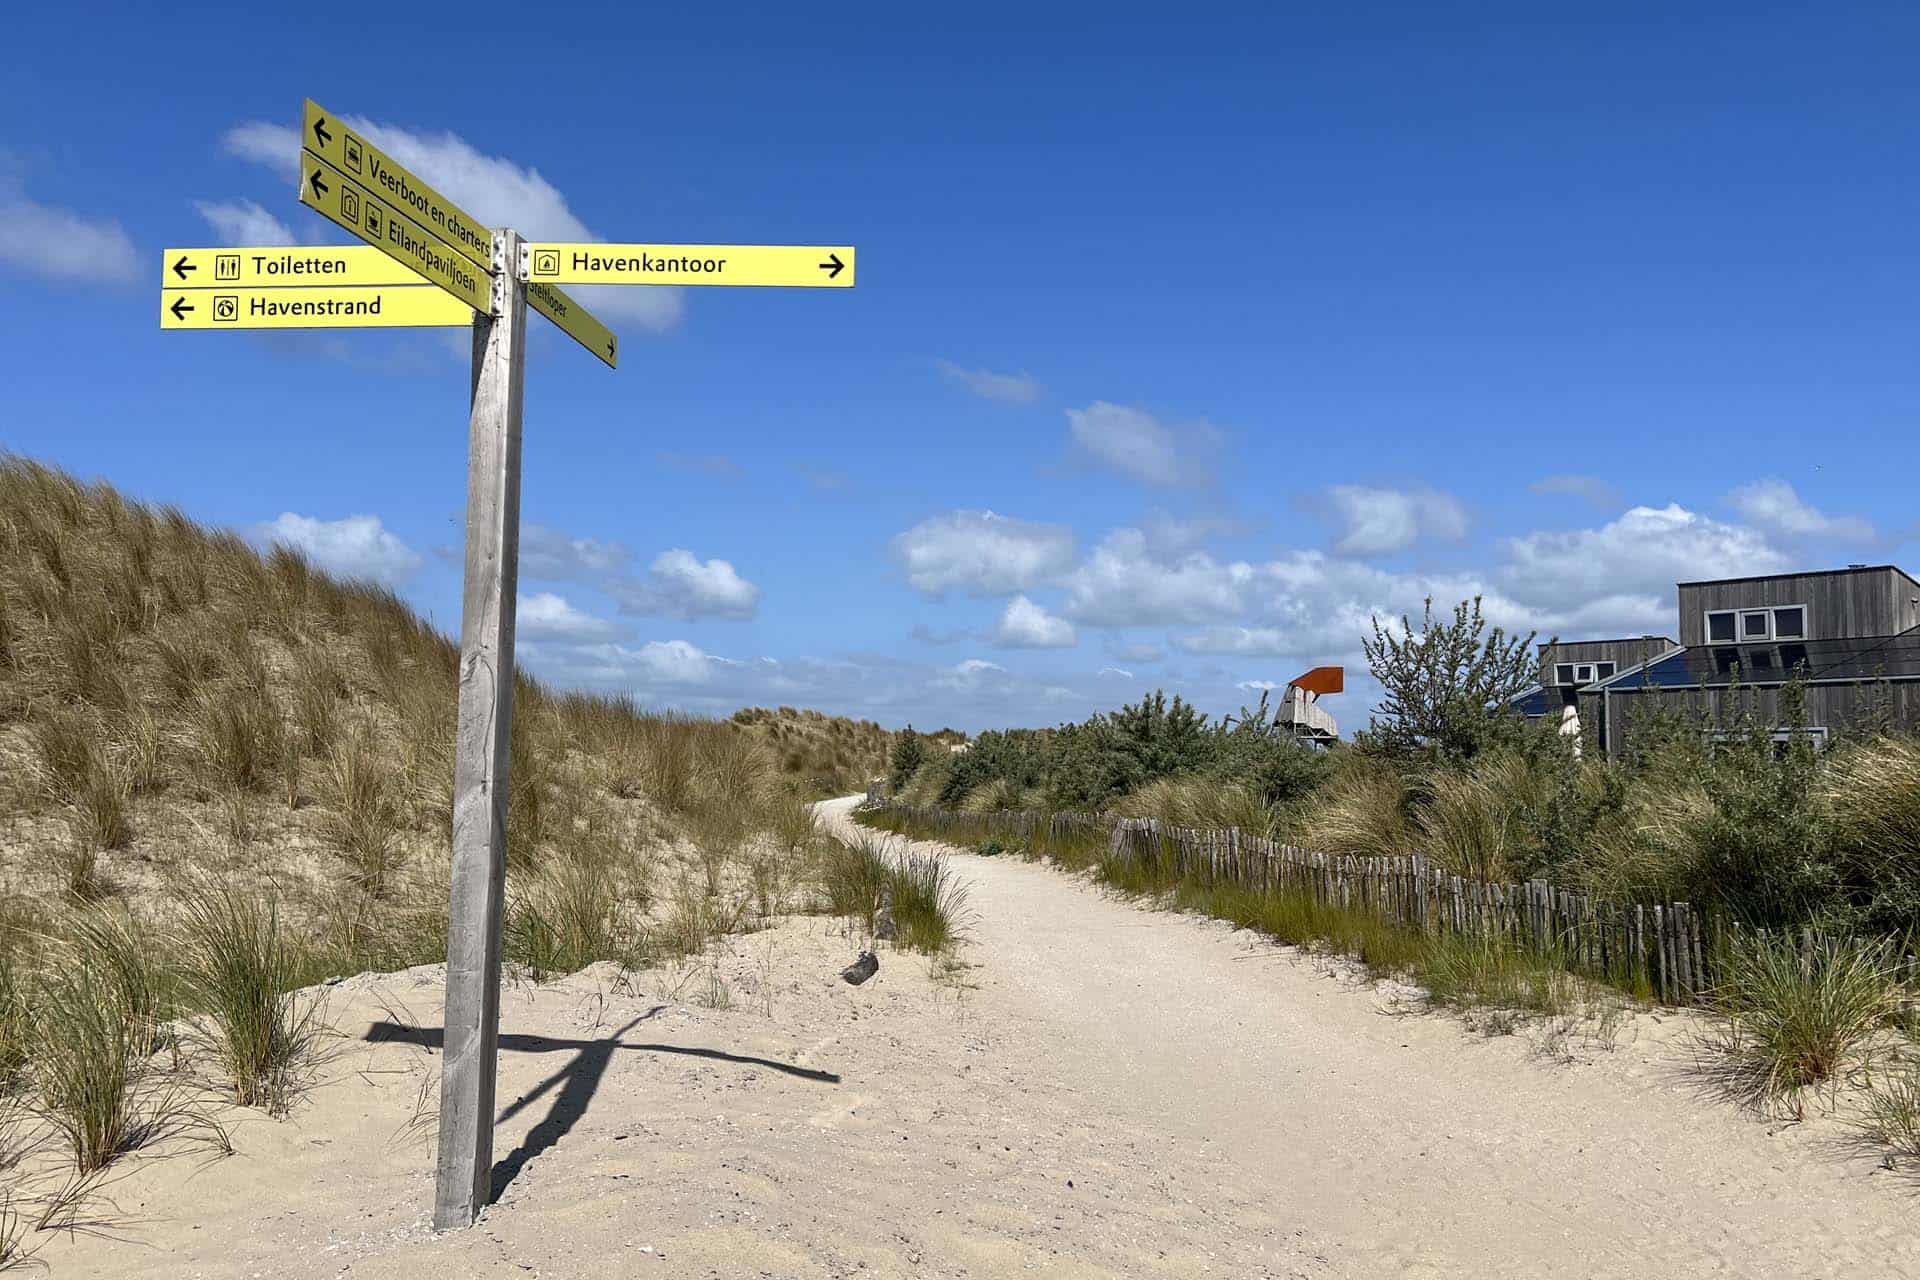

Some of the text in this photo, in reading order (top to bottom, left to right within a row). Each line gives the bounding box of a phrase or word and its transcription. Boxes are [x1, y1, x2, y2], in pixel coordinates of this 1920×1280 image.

[368, 154, 490, 258] Veerboot en charters
[252, 256, 346, 275] Toiletten
[389, 220, 476, 293] Eilandpaviljoen
[573, 252, 726, 273] Havenkantoor
[250, 296, 381, 316] Havenstrand
